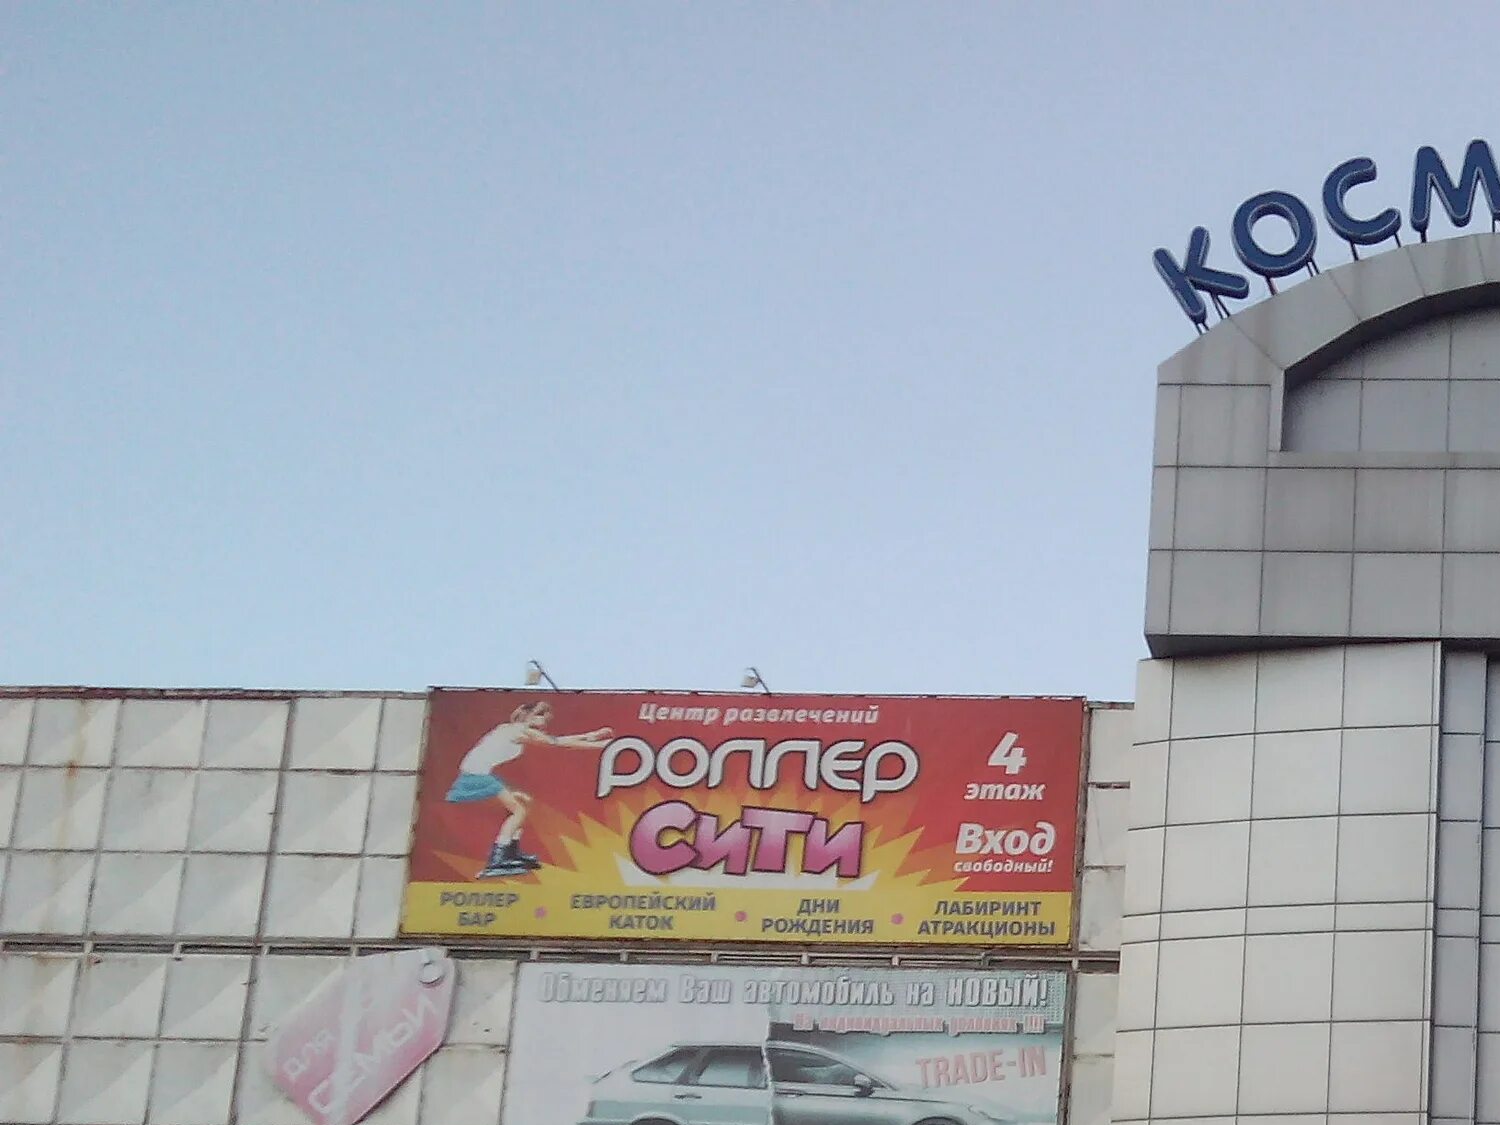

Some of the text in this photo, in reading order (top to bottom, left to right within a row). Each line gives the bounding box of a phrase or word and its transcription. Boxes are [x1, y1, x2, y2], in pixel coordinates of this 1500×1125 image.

[637, 702, 879, 727] Центр развлечений
[986, 731, 1027, 776] 4
[964, 778, 1046, 802] этаж
[954, 821, 1056, 859] Вход
[953, 857, 1054, 876] свободный!
[439, 889, 520, 909] РОЛЛЕР
[570, 890, 717, 913] ЕВРОПЕЙСКИЙ
[796, 897, 841, 918] ДНИ
[933, 899, 1041, 918] ЛАБИРИНТ
[457, 909, 497, 927] БАР
[608, 913, 674, 931] КАТОК
[761, 915, 875, 937] РОЖДЕНИЯ
[917, 917, 1056, 939] АТРАКЦИОНЫ
[541, 972, 1049, 1008] Обменяем Ваш автомобиль на НОВЫЙ!
[915, 1045, 1047, 1090] TRADE-IN
